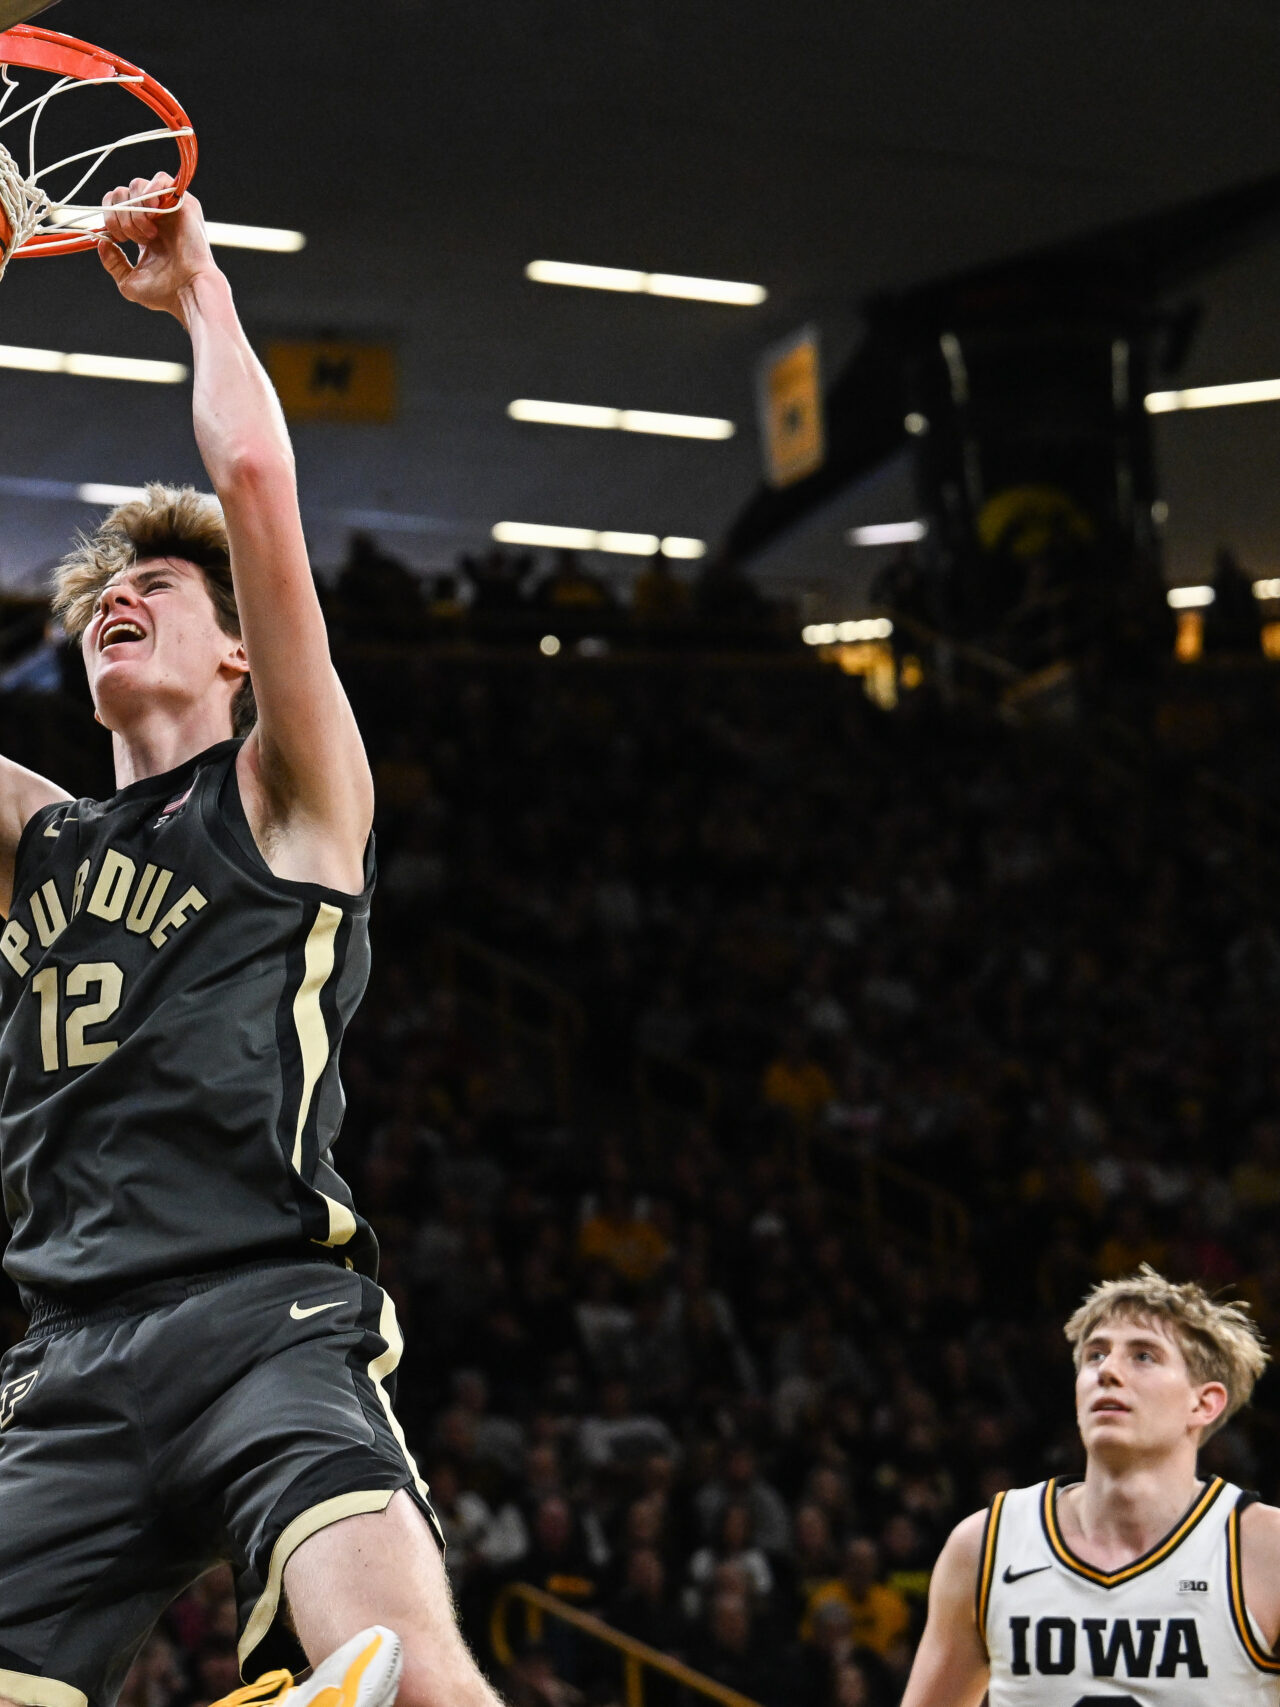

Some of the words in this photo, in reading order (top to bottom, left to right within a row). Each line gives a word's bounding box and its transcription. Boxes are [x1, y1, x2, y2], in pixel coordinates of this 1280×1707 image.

[0, 848, 208, 978] PURDUE
[32, 961, 124, 1073] 12
[1009, 1616, 1209, 1678] IOWA
